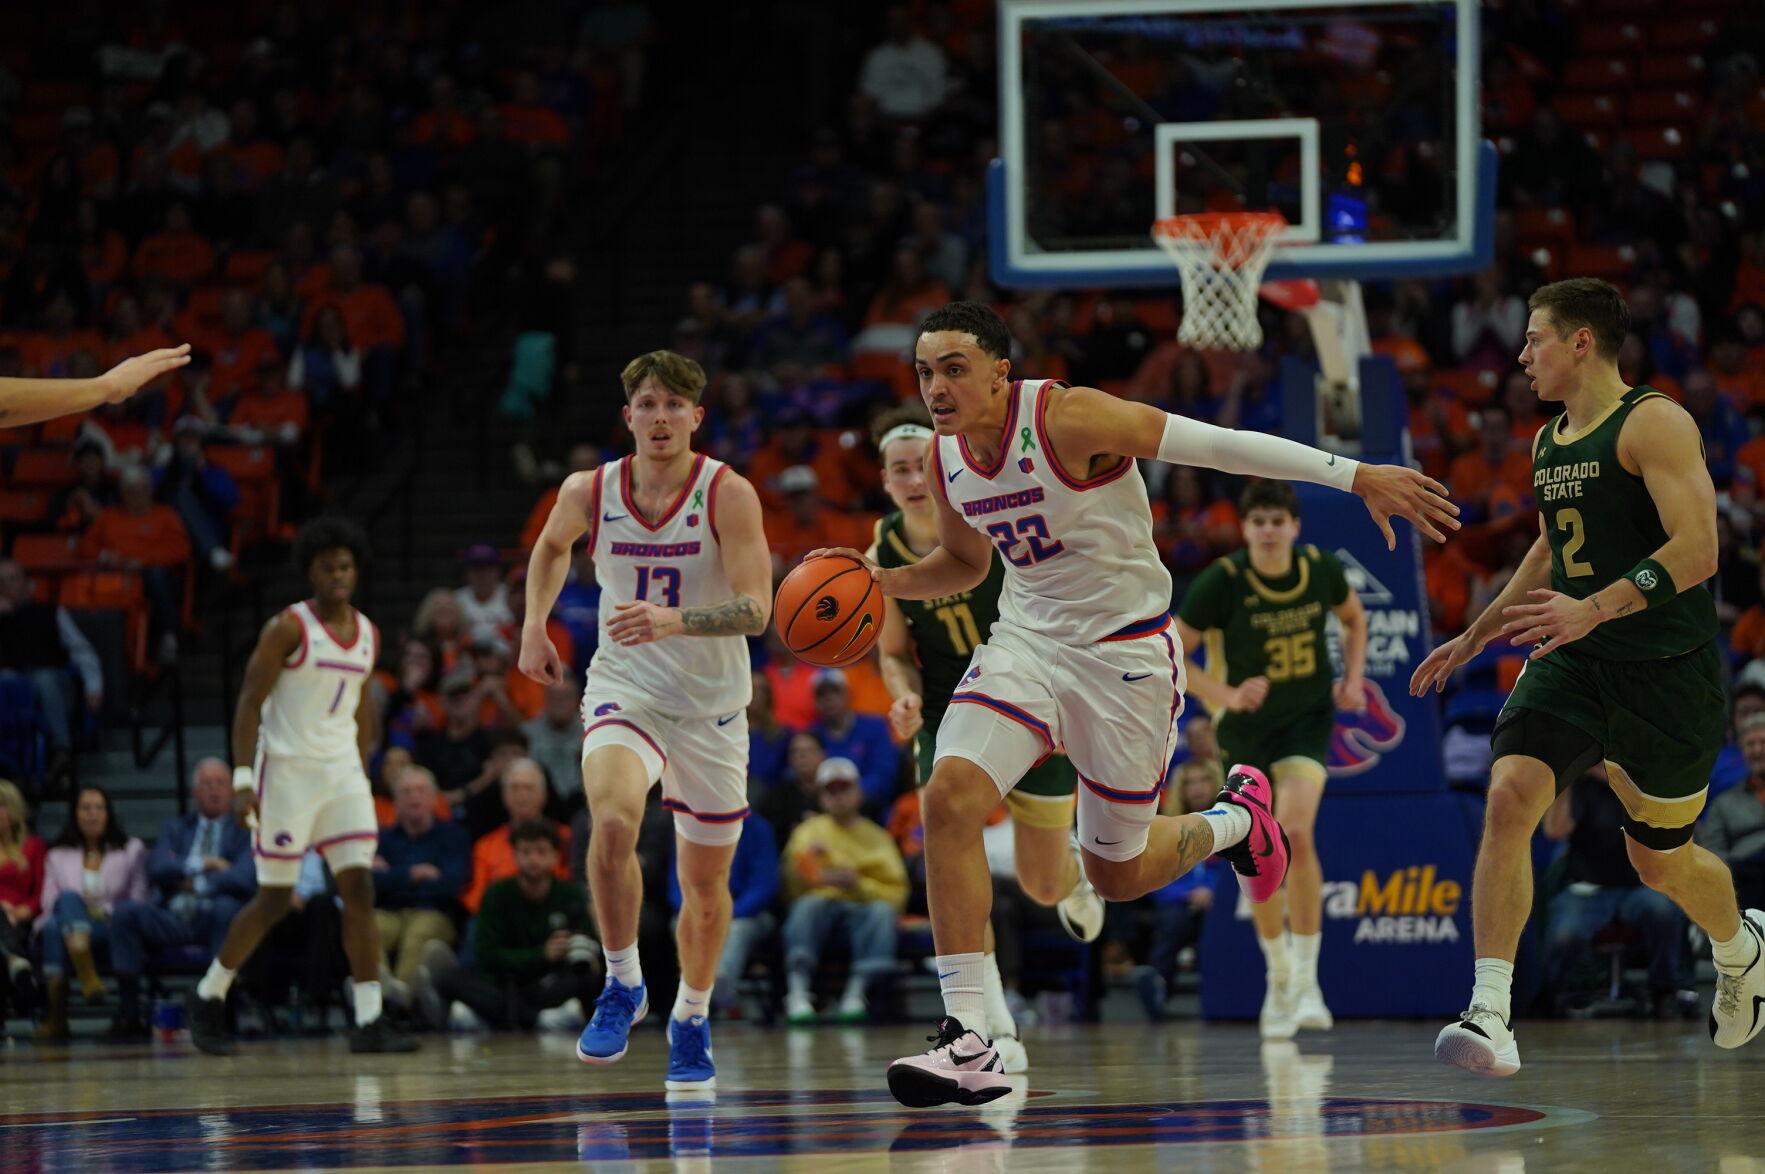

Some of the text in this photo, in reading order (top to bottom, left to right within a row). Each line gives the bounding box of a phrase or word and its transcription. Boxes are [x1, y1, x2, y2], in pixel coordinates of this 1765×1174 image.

[1534, 461, 1600, 487] COLORADO
[1543, 481, 1583, 500] STATE
[962, 487, 1045, 517] BRONCOS
[610, 541, 701, 557] BRONCOS
[986, 514, 1065, 567] 22
[1556, 507, 1595, 578] 2
[634, 566, 681, 608] 13
[934, 602, 983, 657] 11
[1264, 630, 1317, 682] 35
[329, 679, 346, 716] 1
[1354, 916, 1460, 944] ARENA
